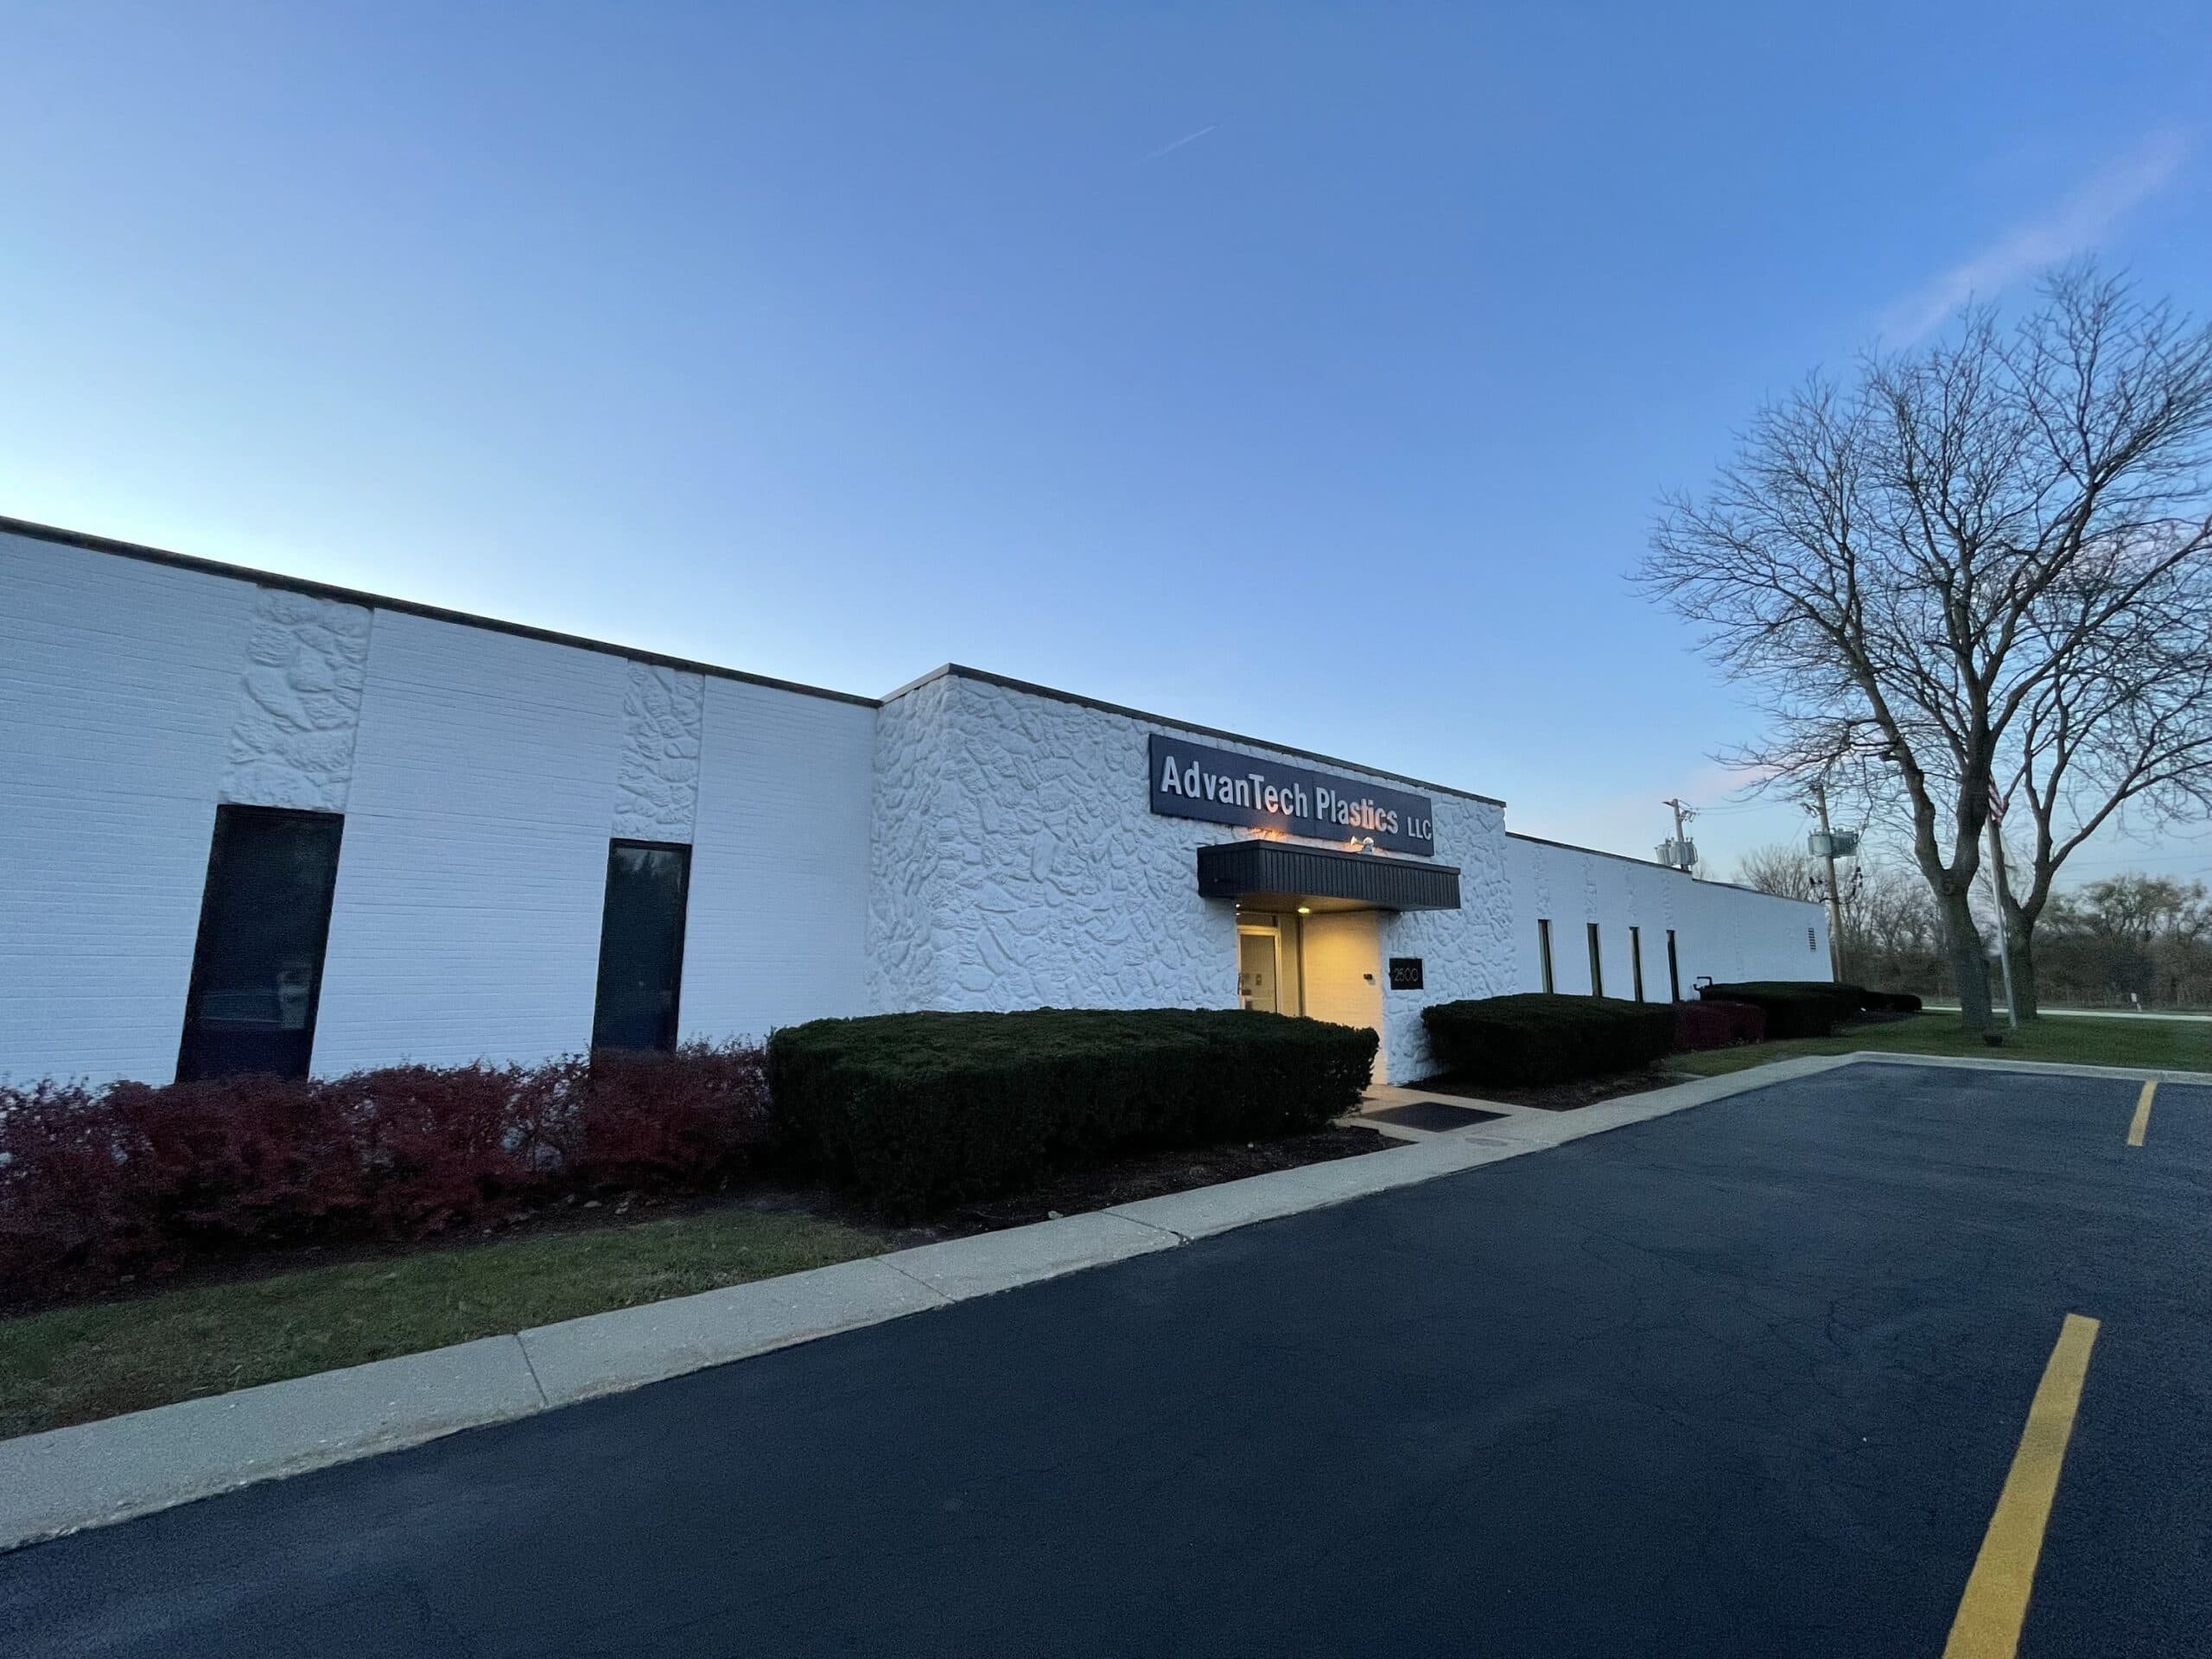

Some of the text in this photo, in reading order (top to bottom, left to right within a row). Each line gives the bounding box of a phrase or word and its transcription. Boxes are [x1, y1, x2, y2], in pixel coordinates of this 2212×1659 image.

[1160, 756, 1432, 840] AdvanTech Plastics LLC
